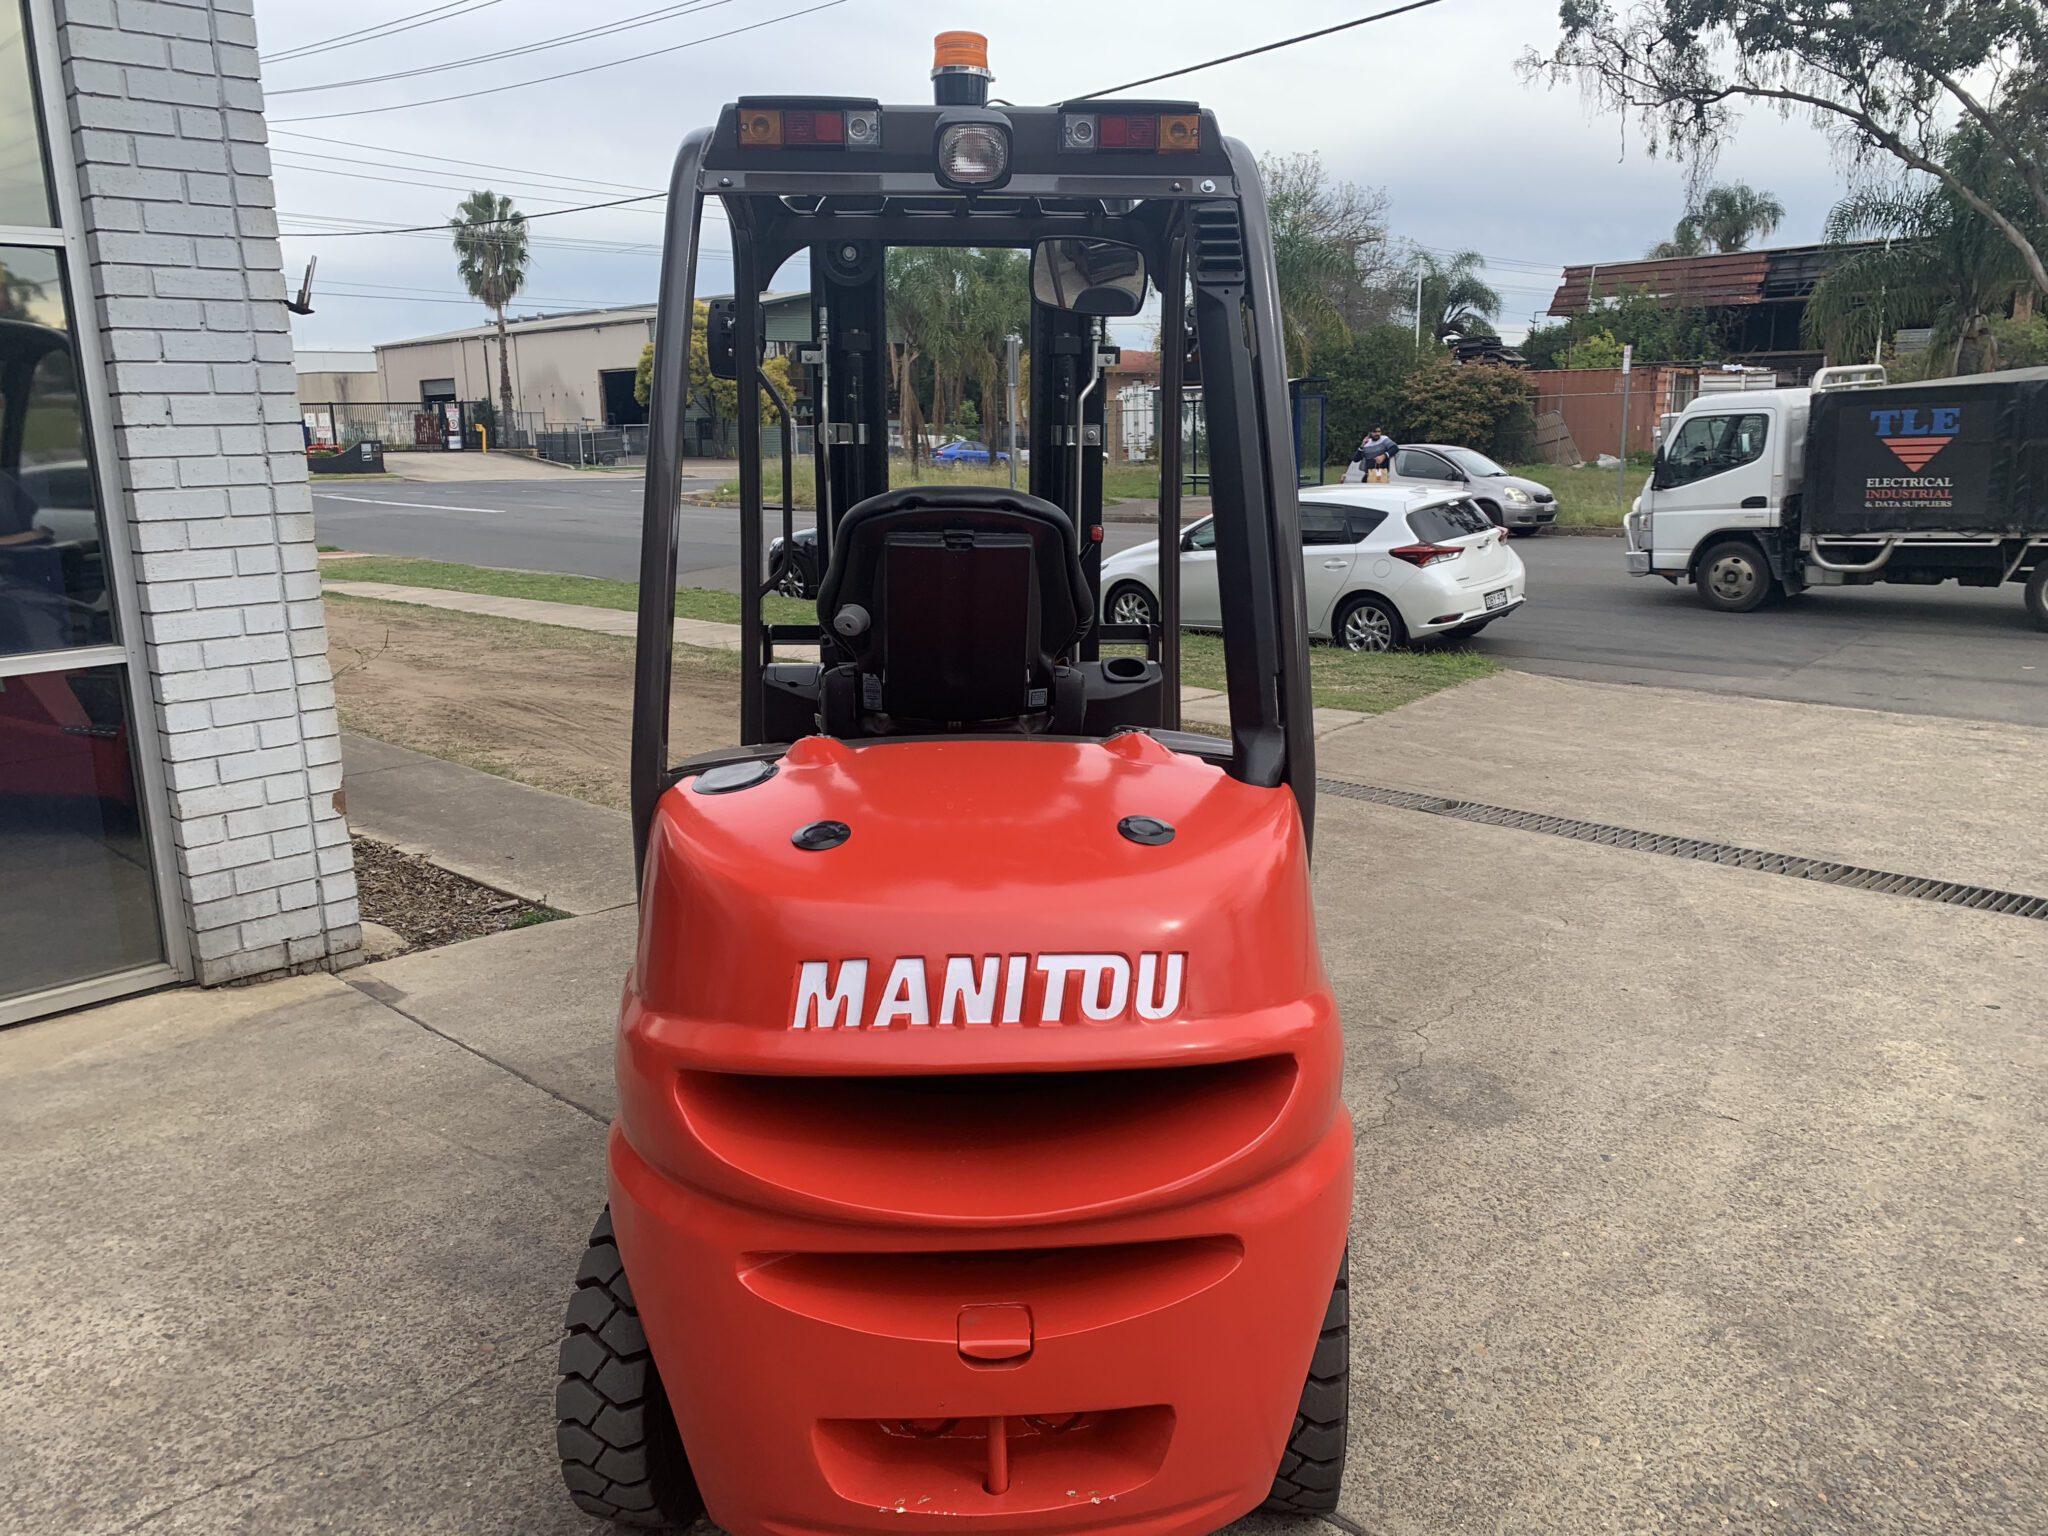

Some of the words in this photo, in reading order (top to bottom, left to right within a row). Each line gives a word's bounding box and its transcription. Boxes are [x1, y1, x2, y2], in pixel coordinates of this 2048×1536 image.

[1870, 408, 1960, 435] TLE
[1866, 477, 1954, 487] ELECTRICAL
[1865, 489, 1953, 499] INDUSTRIAL
[790, 954, 1186, 1029] MANITOU
